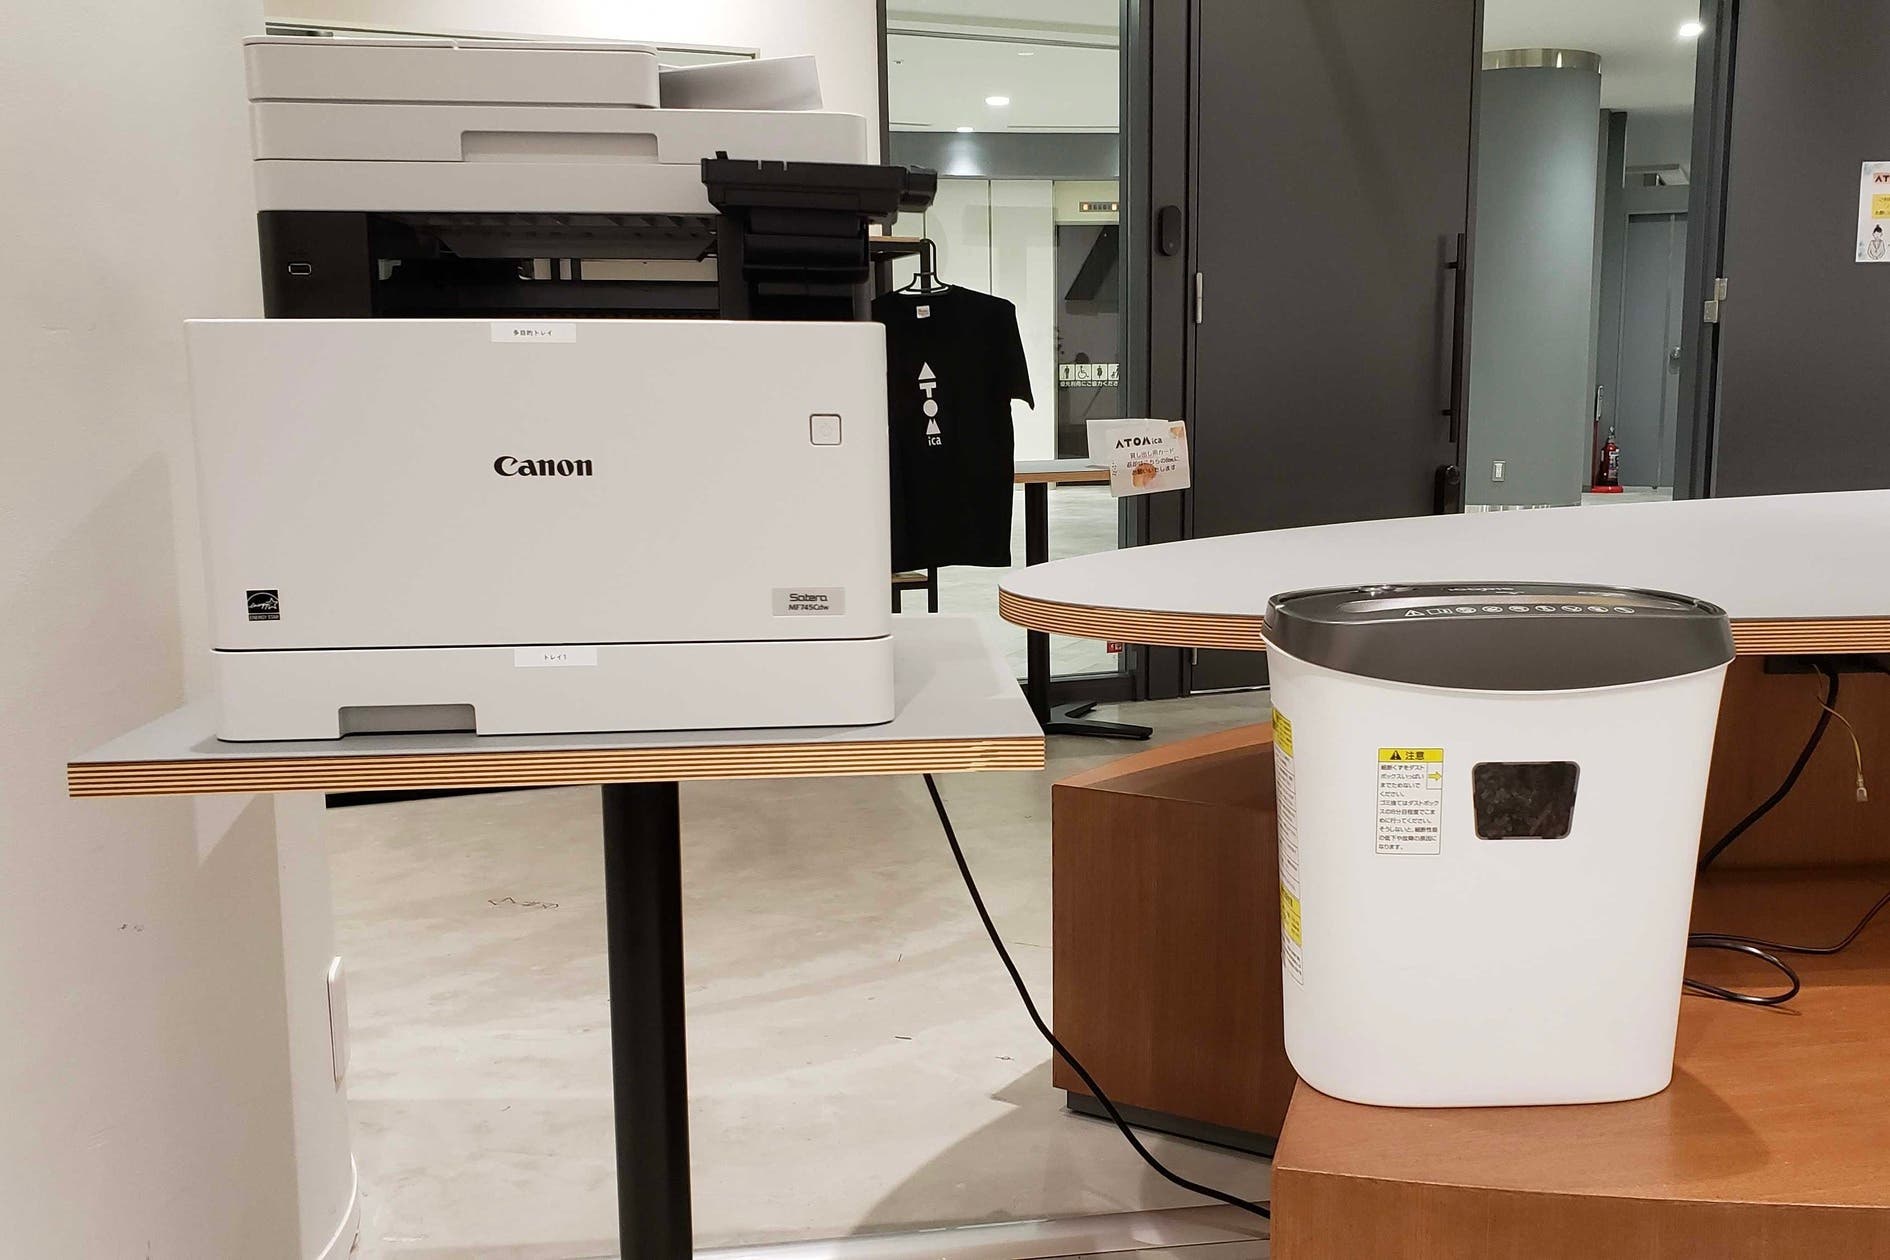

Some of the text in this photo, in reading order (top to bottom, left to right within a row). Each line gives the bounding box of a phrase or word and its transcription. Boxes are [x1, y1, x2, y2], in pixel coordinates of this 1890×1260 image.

[927, 436, 942, 446] ica
[493, 455, 593, 477] Canon
[789, 593, 829, 602] Satera
[1405, 751, 1424, 760] 注意
